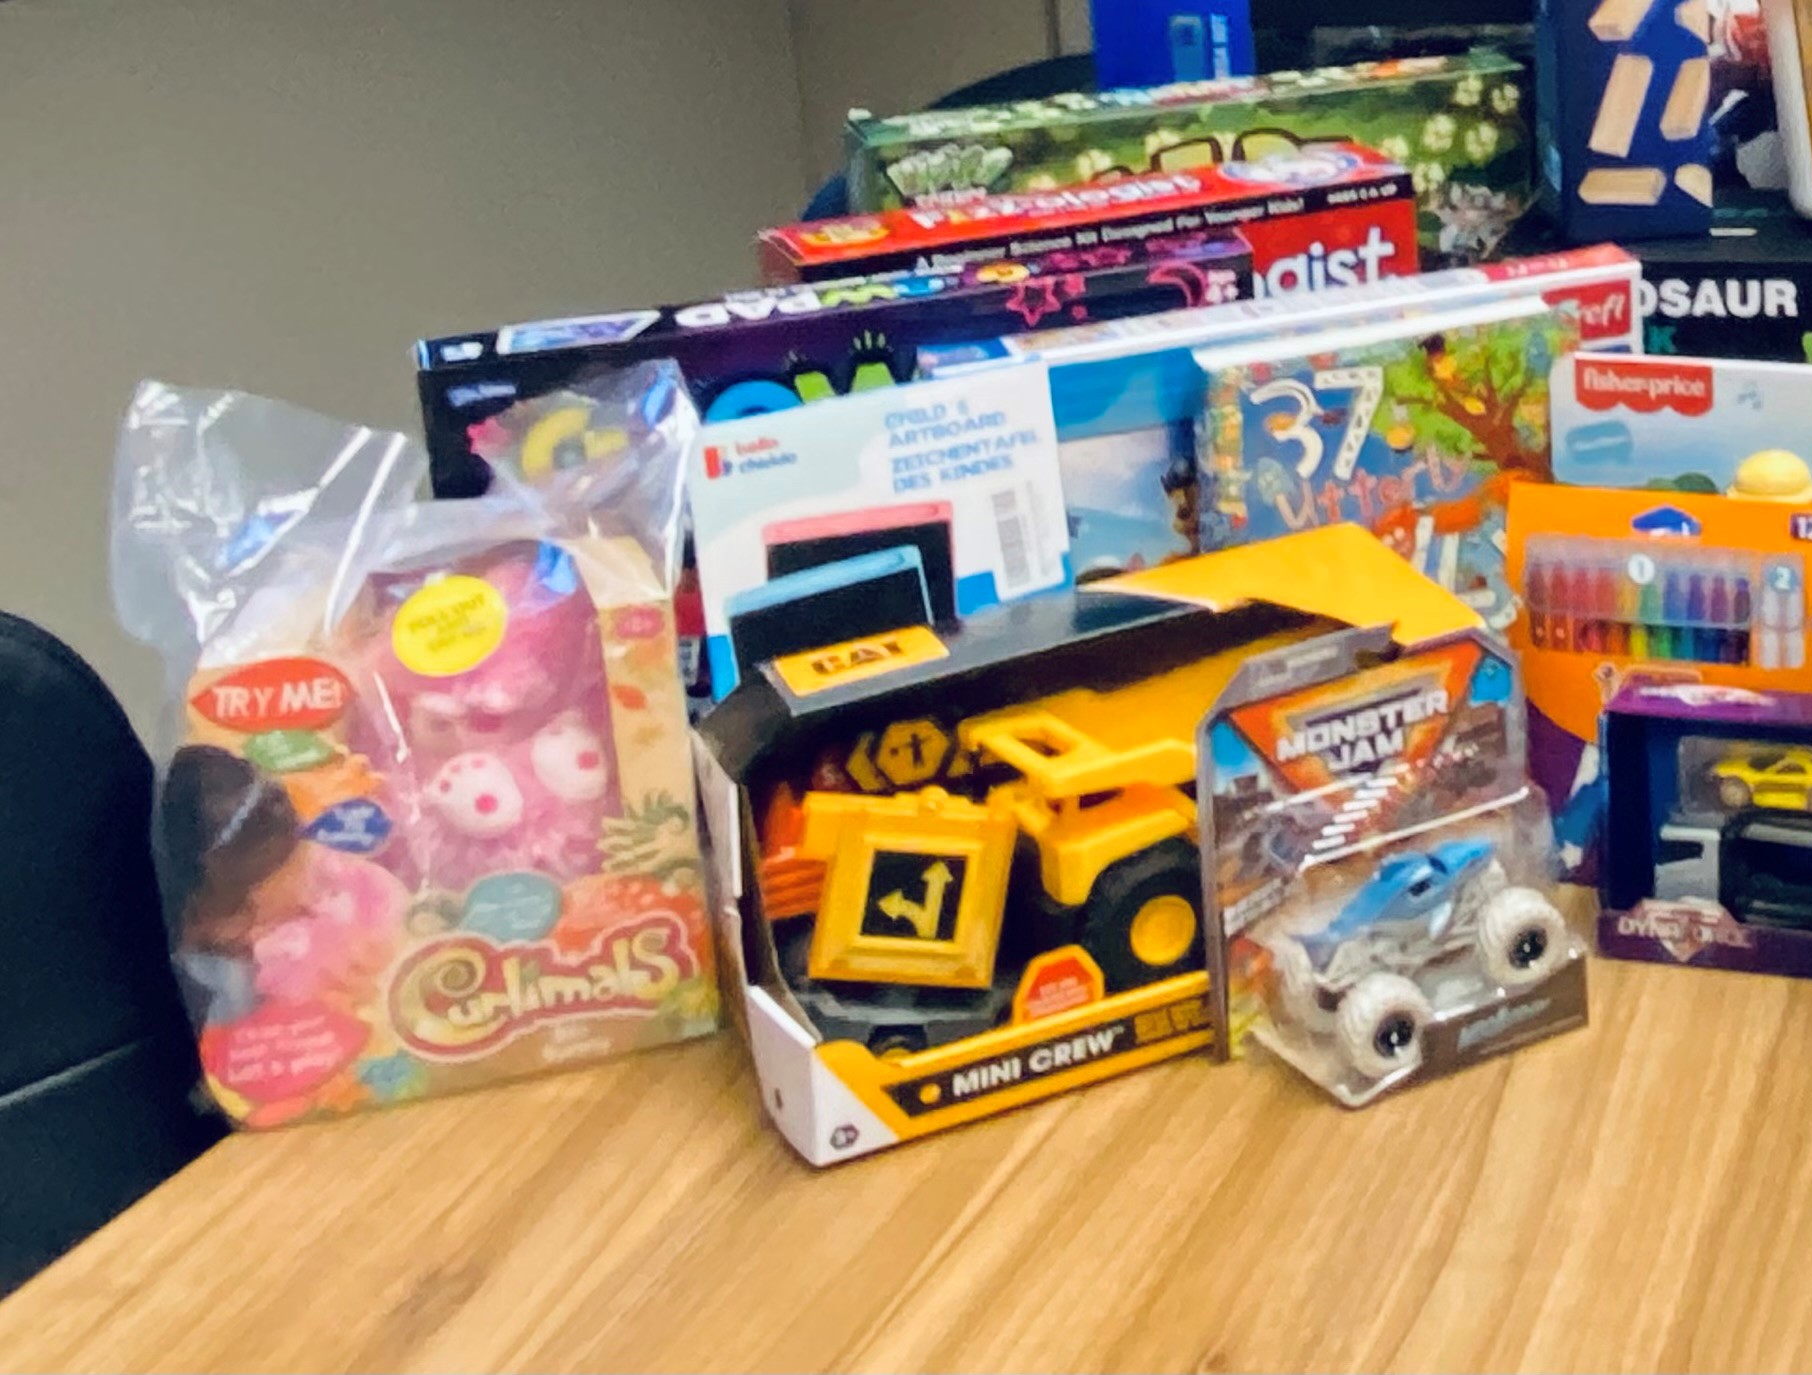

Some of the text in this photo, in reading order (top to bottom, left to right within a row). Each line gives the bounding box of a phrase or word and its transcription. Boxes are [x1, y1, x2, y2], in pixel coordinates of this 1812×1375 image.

[212, 677, 344, 721] TRY ME!
[1276, 690, 1449, 764] MONSTER
[1327, 728, 1404, 772] JAM
[953, 1058, 1021, 1098] MINI
